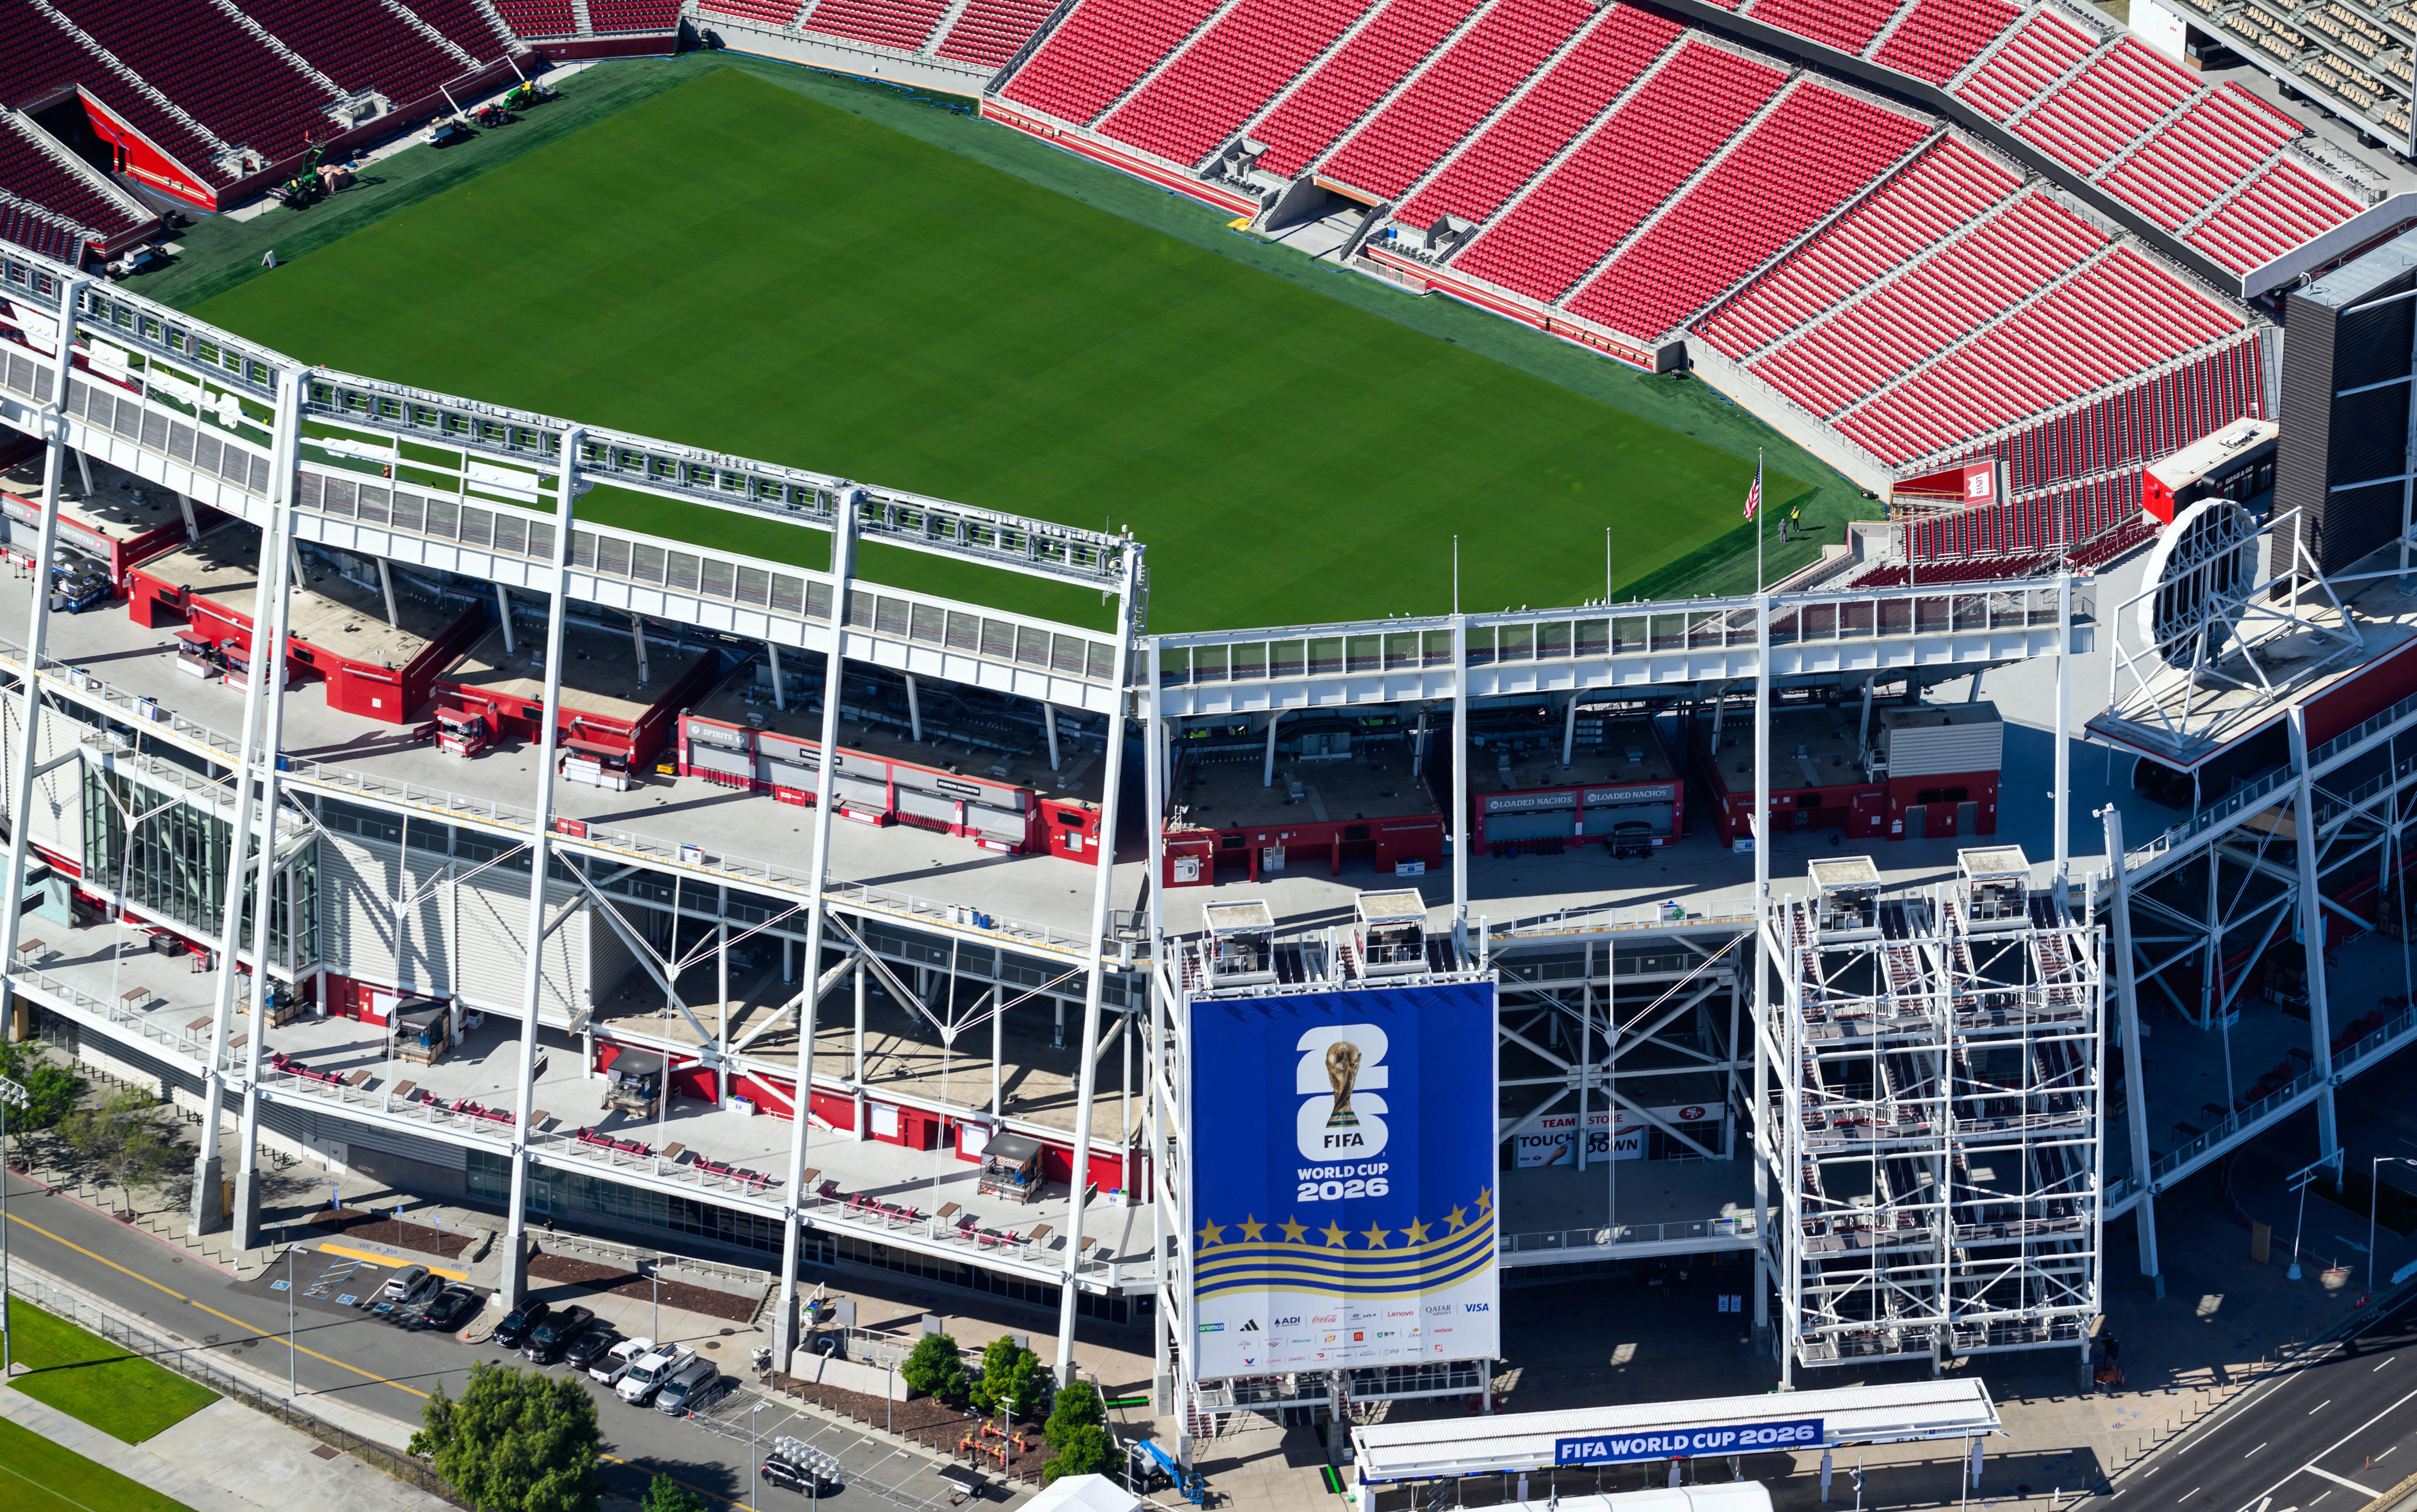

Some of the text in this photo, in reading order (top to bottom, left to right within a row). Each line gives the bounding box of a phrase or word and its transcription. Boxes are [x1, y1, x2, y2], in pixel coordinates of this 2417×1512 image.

[2226, 472, 2240, 484] GRAB
[2245, 465, 2253, 474] GO
[60, 525, 95, 546] FAVORITES
[702, 729, 733, 741] SPIRITS
[938, 781, 979, 794] STADIUM FAVORITES
[1499, 796, 1572, 807] LOADED NACHOS
[1596, 789, 1667, 801] LOADED NACHOS
[1542, 1117, 1576, 1128] TEAM
[1324, 1132, 1364, 1148] FIFA
[1297, 1163, 1389, 1180] WORLD CUP
[1297, 1178, 1389, 1202] 2026
[1426, 1304, 1451, 1313] QATAR
[1465, 1303, 1489, 1312] VISA
[1561, 1425, 1815, 1459] FIFA WORLD CUP 2026
